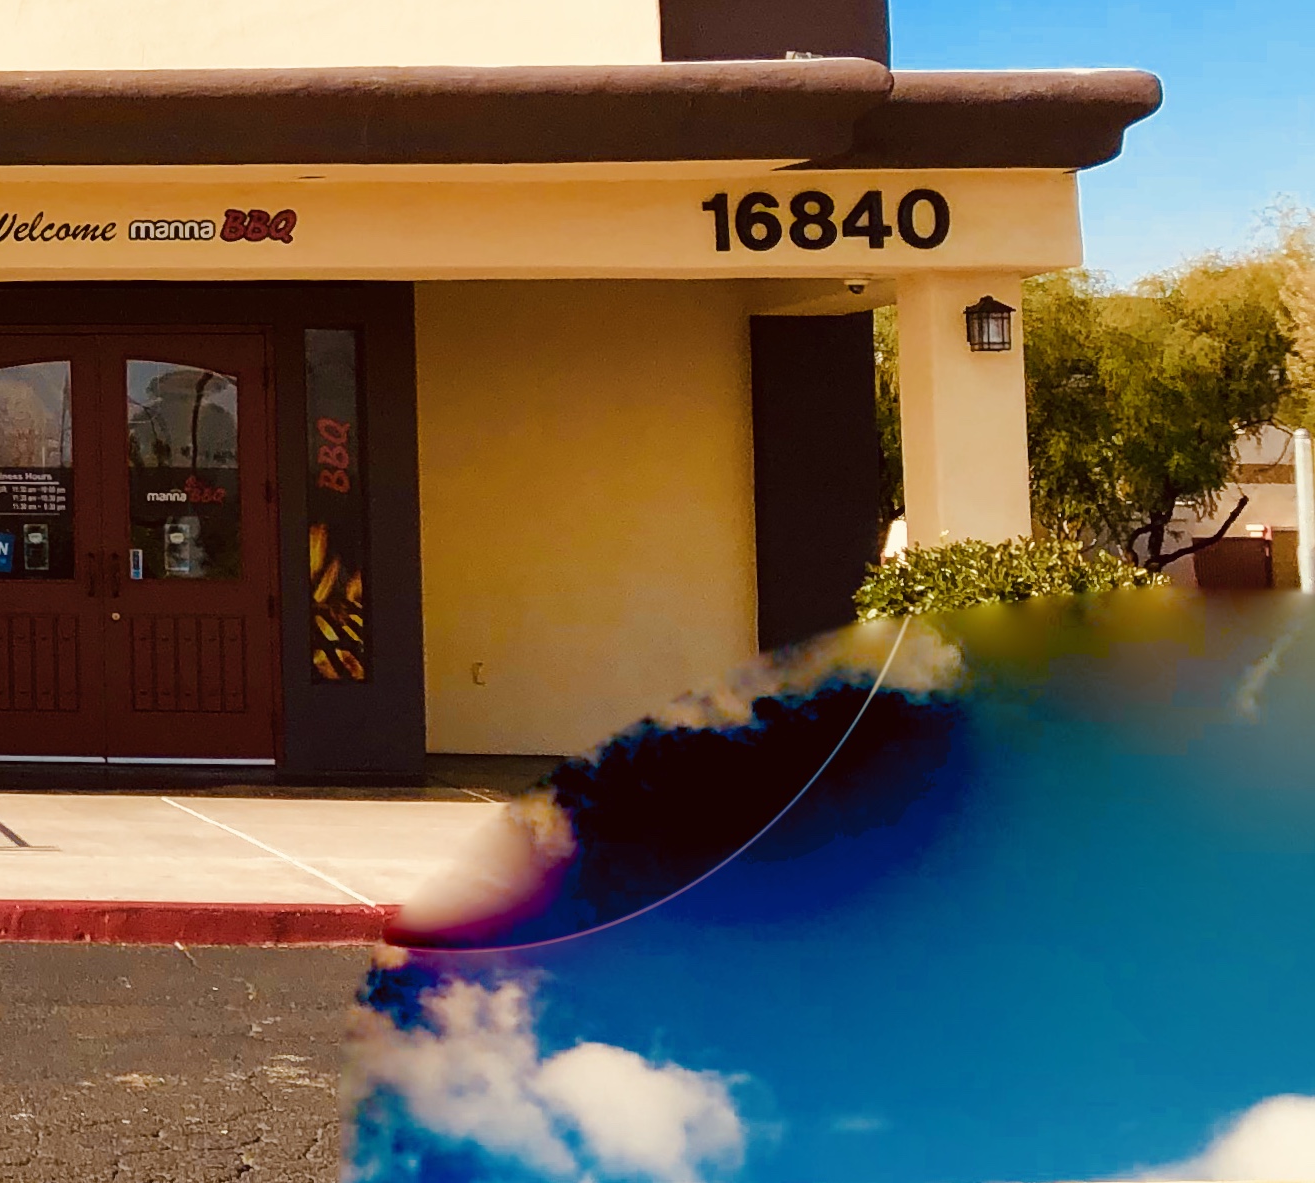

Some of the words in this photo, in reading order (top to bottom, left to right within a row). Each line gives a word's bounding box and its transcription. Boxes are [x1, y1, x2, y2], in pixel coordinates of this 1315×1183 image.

[128, 219, 216, 240] manna
[220, 208, 298, 244] BBQ
[702, 188, 951, 252] 16840
[316, 417, 351, 494] BBQ
[25, 472, 53, 481] Hours
[146, 492, 187, 503] manna
